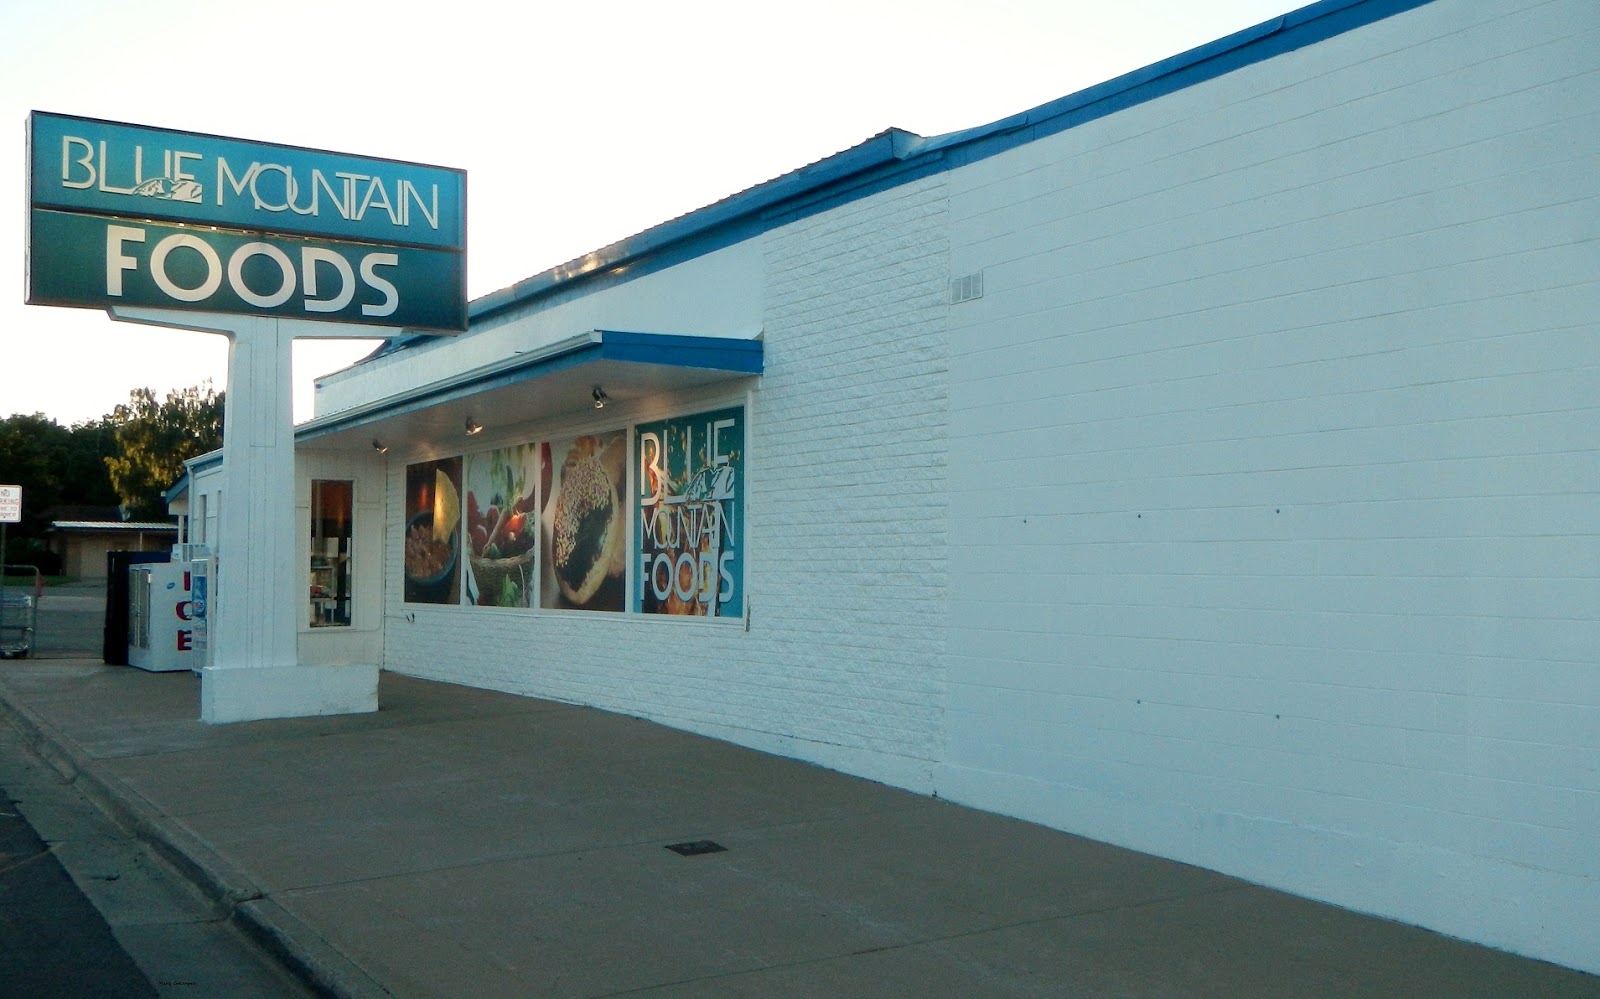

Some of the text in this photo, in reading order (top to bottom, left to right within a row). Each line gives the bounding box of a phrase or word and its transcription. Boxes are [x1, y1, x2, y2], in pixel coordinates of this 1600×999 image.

[62, 135, 438, 230] BLUE MOUNTAIN
[106, 224, 399, 317] FOODS
[640, 418, 735, 506] BLUE
[640, 501, 735, 550] MOUNTAIN
[640, 551, 735, 603] FOODS
